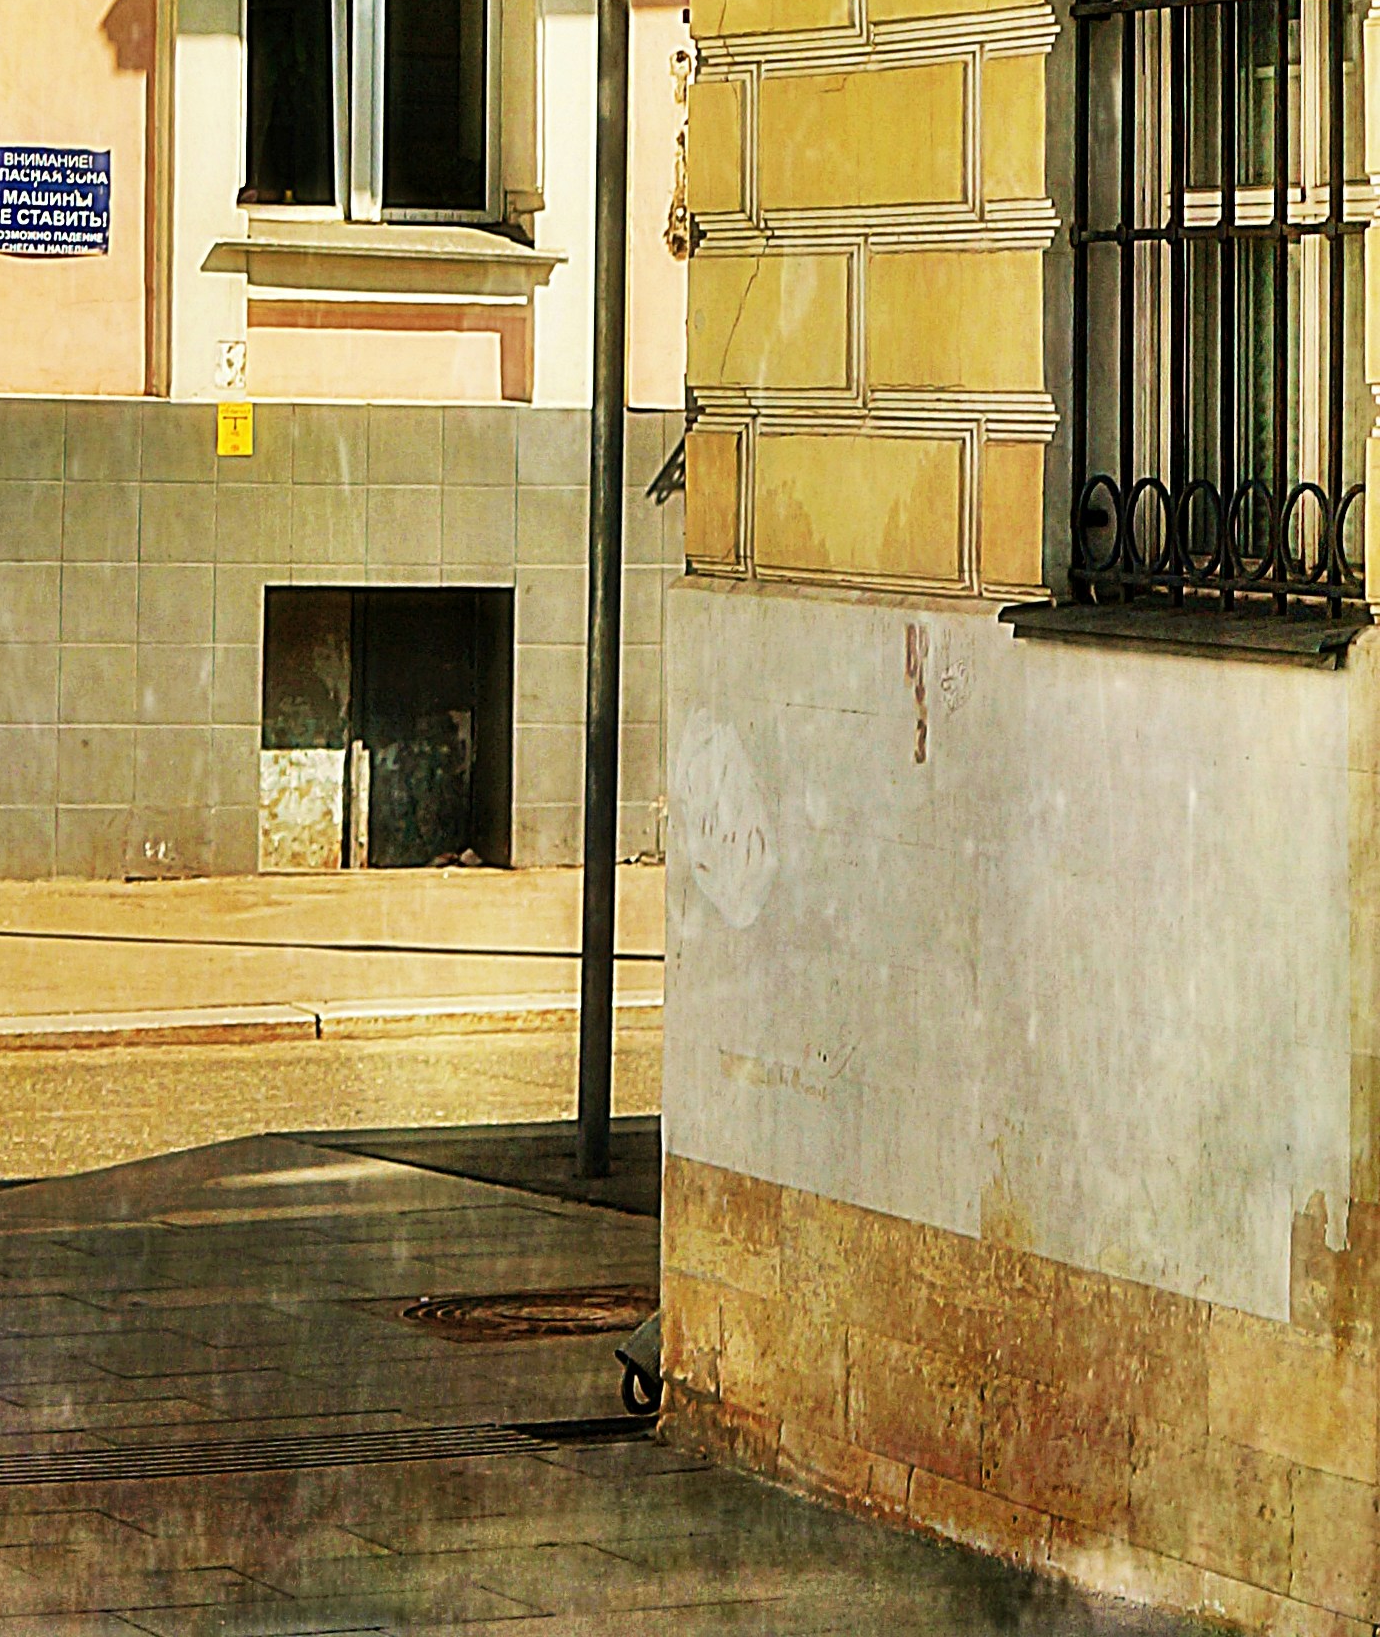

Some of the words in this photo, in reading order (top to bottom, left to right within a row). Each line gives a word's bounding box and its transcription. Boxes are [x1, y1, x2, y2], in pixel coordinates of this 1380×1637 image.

[3, 152, 93, 168] ВНИМАНИЕ!
[66, 171, 109, 185] ЗОНА
[3, 190, 93, 207] МАШИНЫ
[16, 210, 108, 228] СТАВИТЬ!
[53, 231, 104, 243] ПАДЕНИЕ
